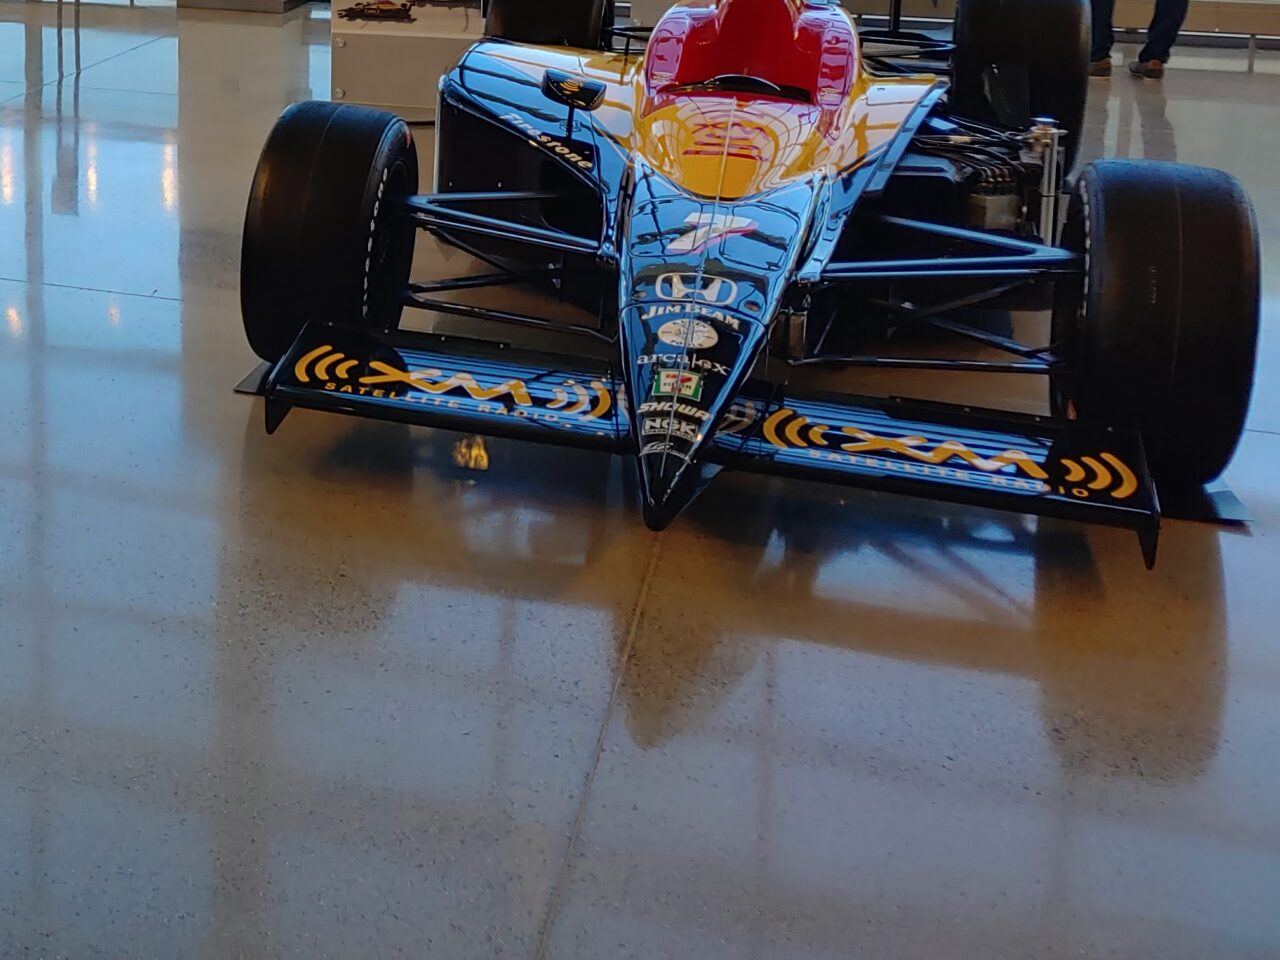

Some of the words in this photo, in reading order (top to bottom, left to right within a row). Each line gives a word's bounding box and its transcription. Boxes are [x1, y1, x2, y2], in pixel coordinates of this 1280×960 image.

[499, 112, 593, 169] Firestone
[666, 212, 758, 254] 7
[641, 303, 682, 320] JIM
[684, 303, 741, 331] BEAM
[324, 381, 459, 410] SATELLITE
[477, 403, 560, 423] RADIO
[358, 361, 533, 407] XM
[636, 401, 712, 422] SHOWA
[644, 418, 697, 439] NGK
[808, 448, 972, 481] SATELLITE
[991, 475, 1090, 498] RADIO
[840, 426, 1050, 480] XM
